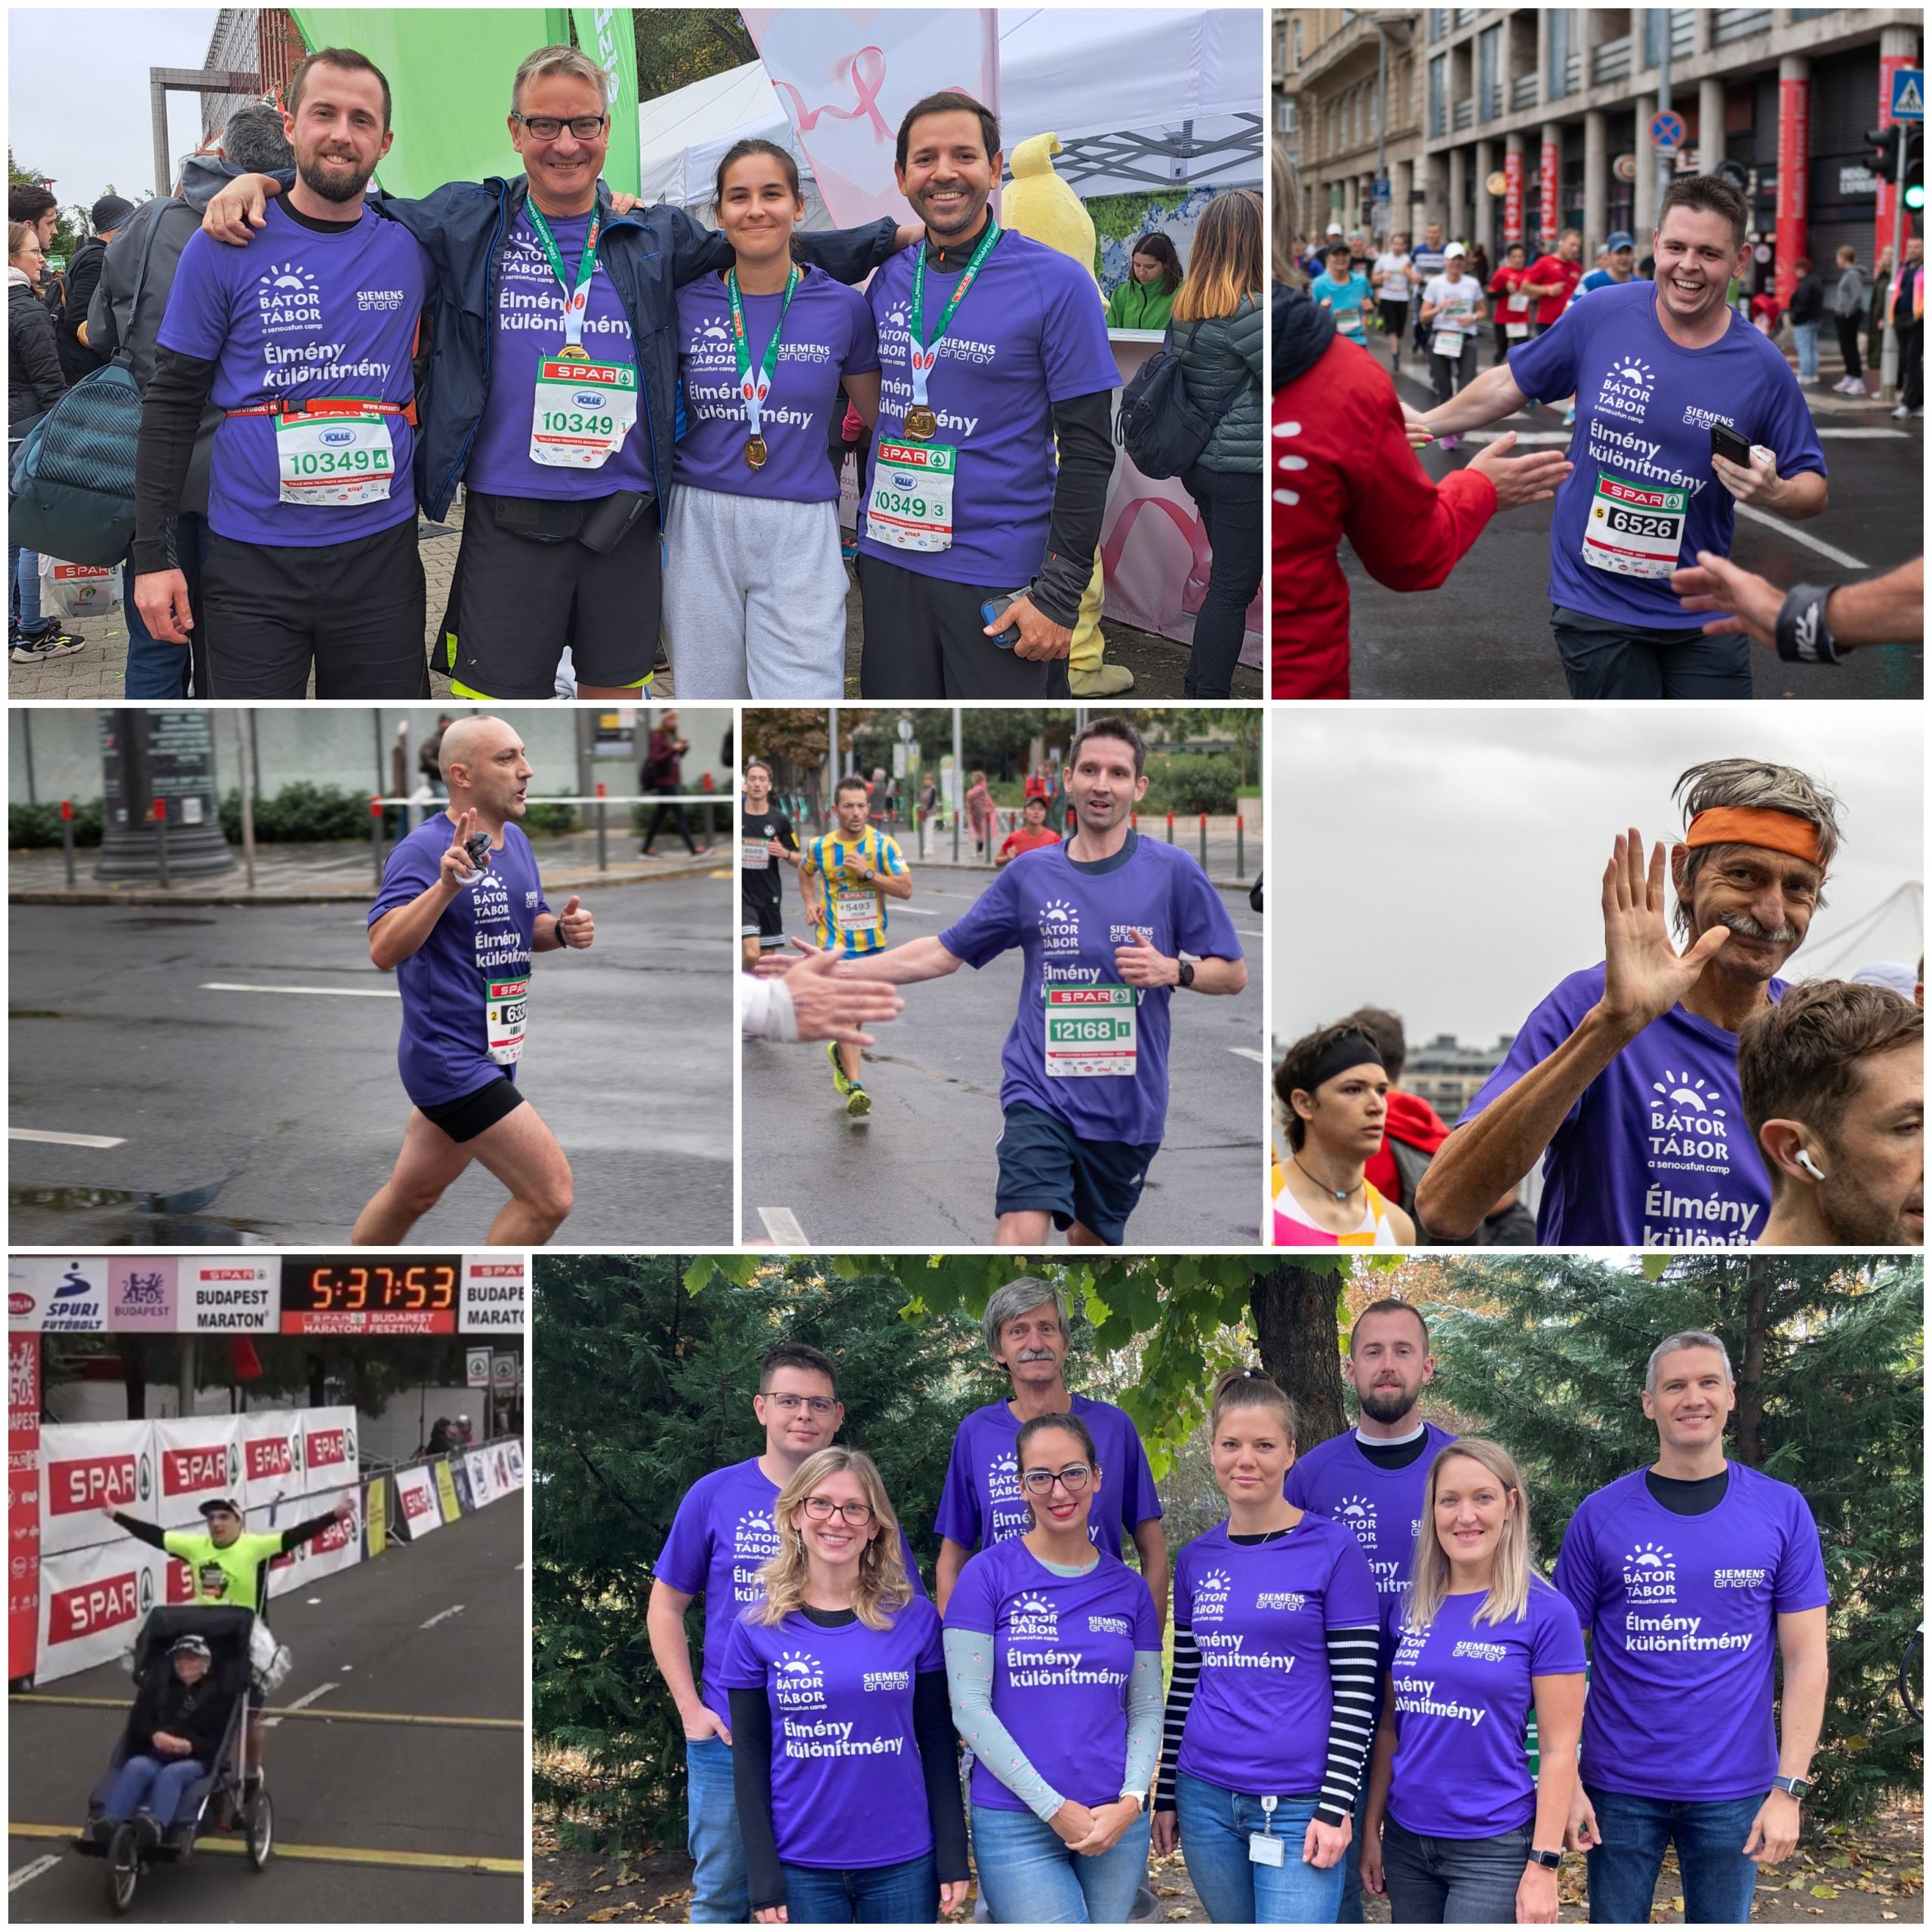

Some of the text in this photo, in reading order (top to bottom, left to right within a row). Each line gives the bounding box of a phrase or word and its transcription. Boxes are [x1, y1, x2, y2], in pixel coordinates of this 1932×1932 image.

[974, 240, 993, 266] BUDAPEST
[501, 261, 553, 275] TÁBOR
[259, 293, 320, 309] BÁTOR
[357, 291, 404, 301] SIEMENS
[500, 288, 564, 309] Élmén
[358, 300, 403, 310] energy
[260, 308, 321, 325] TÁBOR
[500, 313, 632, 339] különímény
[264, 341, 346, 365] Élmény
[778, 344, 830, 355] SIEMENS
[878, 341, 906, 357] ÁBOR
[941, 337, 996, 354] SIEMENS
[777, 352, 829, 364] energy
[940, 346, 995, 365] energy
[263, 358, 392, 386] különítmény
[558, 366, 615, 380] SPAR
[690, 380, 744, 400] Élmén
[1603, 379, 1651, 403] BÁTOR
[1599, 392, 1646, 416] TÁBOR
[543, 412, 613, 435] 10349
[1628, 415, 1644, 424] camp
[1684, 405, 1735, 427] SIEMENS
[1590, 418, 1661, 460] Élmény
[290, 450, 386, 475] 10349 4
[883, 448, 925, 462] SPAR
[1589, 441, 1707, 496] különítmény
[1611, 485, 1662, 505] SPAR
[875, 491, 943, 517] 10349 3
[1597, 509, 1672, 537] 5 6526
[473, 891, 508, 905] BÁTOR
[474, 903, 509, 917] TÁBOR
[846, 902, 870, 911] 5493
[1041, 924, 1078, 937] BÁTOR
[475, 930, 520, 949] Élmény
[1043, 937, 1078, 948] TÁBOR
[1043, 962, 1101, 984] Élmény
[1061, 992, 1109, 1001] SPAR
[491, 1005, 526, 1023] 2 633
[1054, 1022, 1126, 1039] 12168 1
[1651, 1109, 1727, 1137] BÁTOR
[1648, 1133, 1729, 1161] TÁBOR
[1706, 1165, 1730, 1175] camp
[1645, 1183, 1760, 1232] Élmény
[1643, 1226, 1756, 1246] különít
[209, 1270, 254, 1280] SPAR
[312, 1266, 454, 1308] 5:37:53
[467, 1287, 524, 1302] BUDAPE
[196, 1291, 269, 1305] BUDAPEST
[46, 1303, 99, 1316] SPURI
[115, 1306, 170, 1316] BUDAPEST
[371, 1313, 434, 1323] BUDAPEST
[368, 1322, 432, 1334] FESZTIVÁL
[315, 1435, 344, 1461] SPAR
[8, 1455, 27, 1467] PAR
[256, 1443, 291, 1472] SPAR
[177, 1452, 226, 1487] SPAR
[70, 1463, 136, 1503] SPAR
[989, 1474, 1019, 1487] BÁTO
[989, 1486, 1020, 1498] TÁBO
[993, 1509, 1031, 1527] Élmé
[736, 1531, 781, 1543] BÁTOR
[734, 1543, 780, 1555] TÁBOR
[1367, 1558, 1398, 1578] ény
[1714, 1570, 1765, 1579] SIEMENS
[1623, 1570, 1676, 1584] BÁTOR
[1714, 1578, 1764, 1588] energy
[1258, 1593, 1305, 1603] SIEMENS
[1626, 1583, 1676, 1597] TÁBOR
[71, 1580, 136, 1630] SPAR
[1257, 1601, 1304, 1611] energy
[1011, 1614, 1057, 1625] BÁTOR
[1088, 1617, 1128, 1629] SIEMENS
[1626, 1611, 1701, 1635] Élmény
[1402, 1636, 1426, 1647] TOR
[1455, 1641, 1506, 1654] SIEMENS
[1626, 1632, 1752, 1651] különítmény
[1008, 1647, 1081, 1669] Élmény
[1453, 1649, 1504, 1663] energy
[777, 1676, 824, 1690] BÁTOR
[863, 1671, 909, 1682] SIEMENS
[1010, 1668, 1128, 1689] különítmény
[864, 1680, 909, 1691] energy
[1393, 1676, 1435, 1698] mény
[777, 1690, 825, 1704] TÁBOR
[784, 1718, 853, 1740] Élmény
[786, 1737, 903, 1758] különítmény
